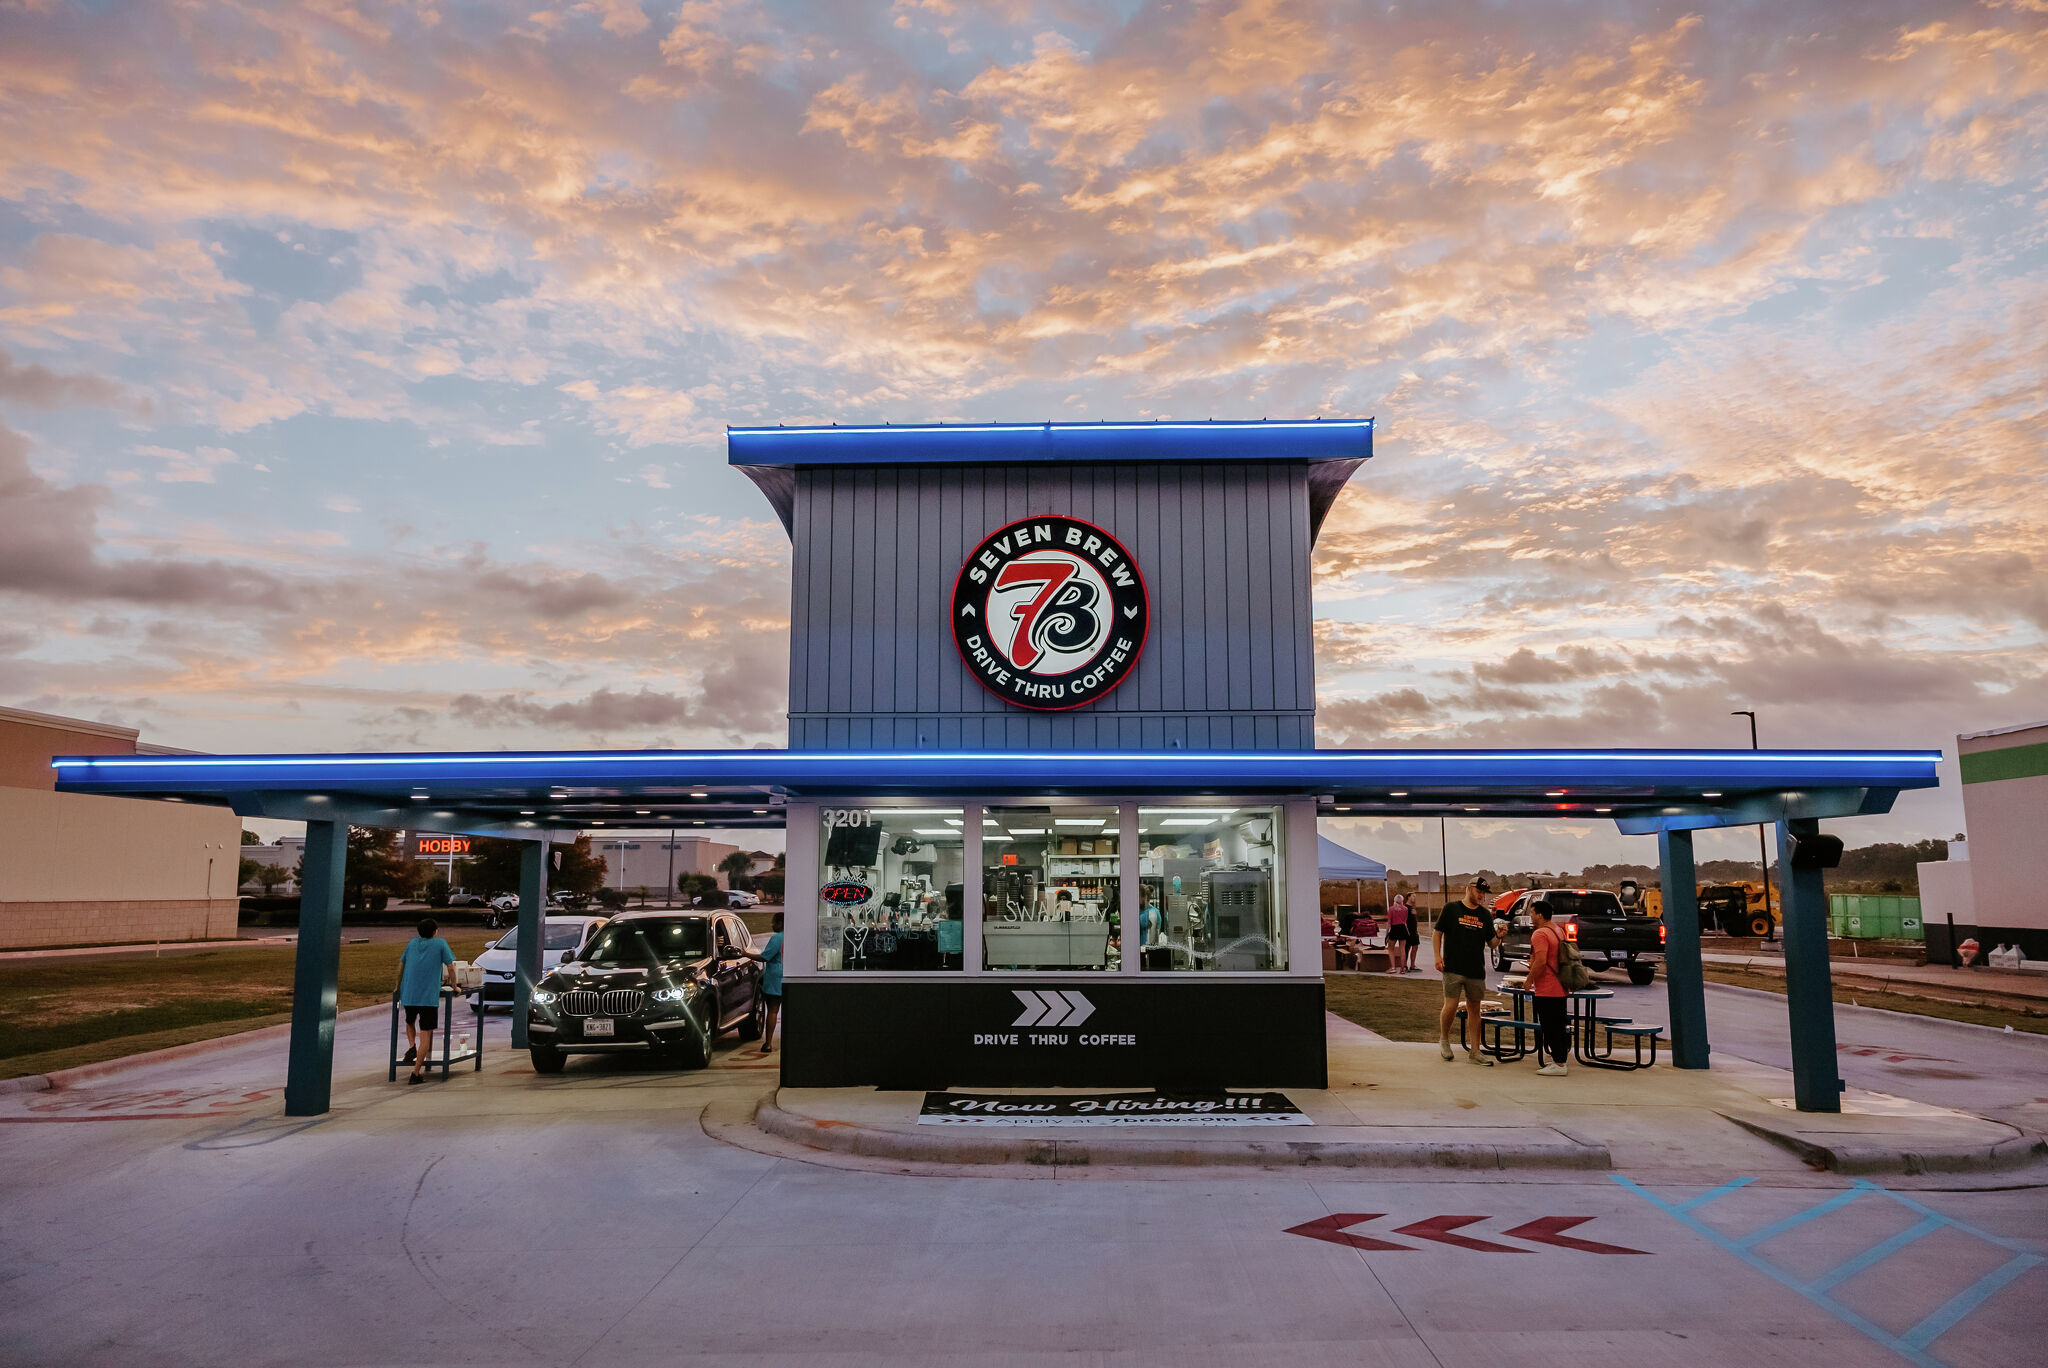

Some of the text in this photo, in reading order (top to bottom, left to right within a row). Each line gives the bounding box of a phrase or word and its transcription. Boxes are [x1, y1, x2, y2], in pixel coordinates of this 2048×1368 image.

[970, 525, 1135, 587] SEVEN BREW
[966, 635, 1132, 698] DRIVE THRU COFFEE
[823, 809, 871, 828] 3201
[419, 840, 471, 853] HOBBY
[823, 887, 866, 899] OPEN
[973, 1034, 1137, 1046] DRIVE THRU COFFEE
[949, 1097, 1262, 1113] Now Hiring!!!
[1108, 1116, 1237, 1124] 7brew.com
